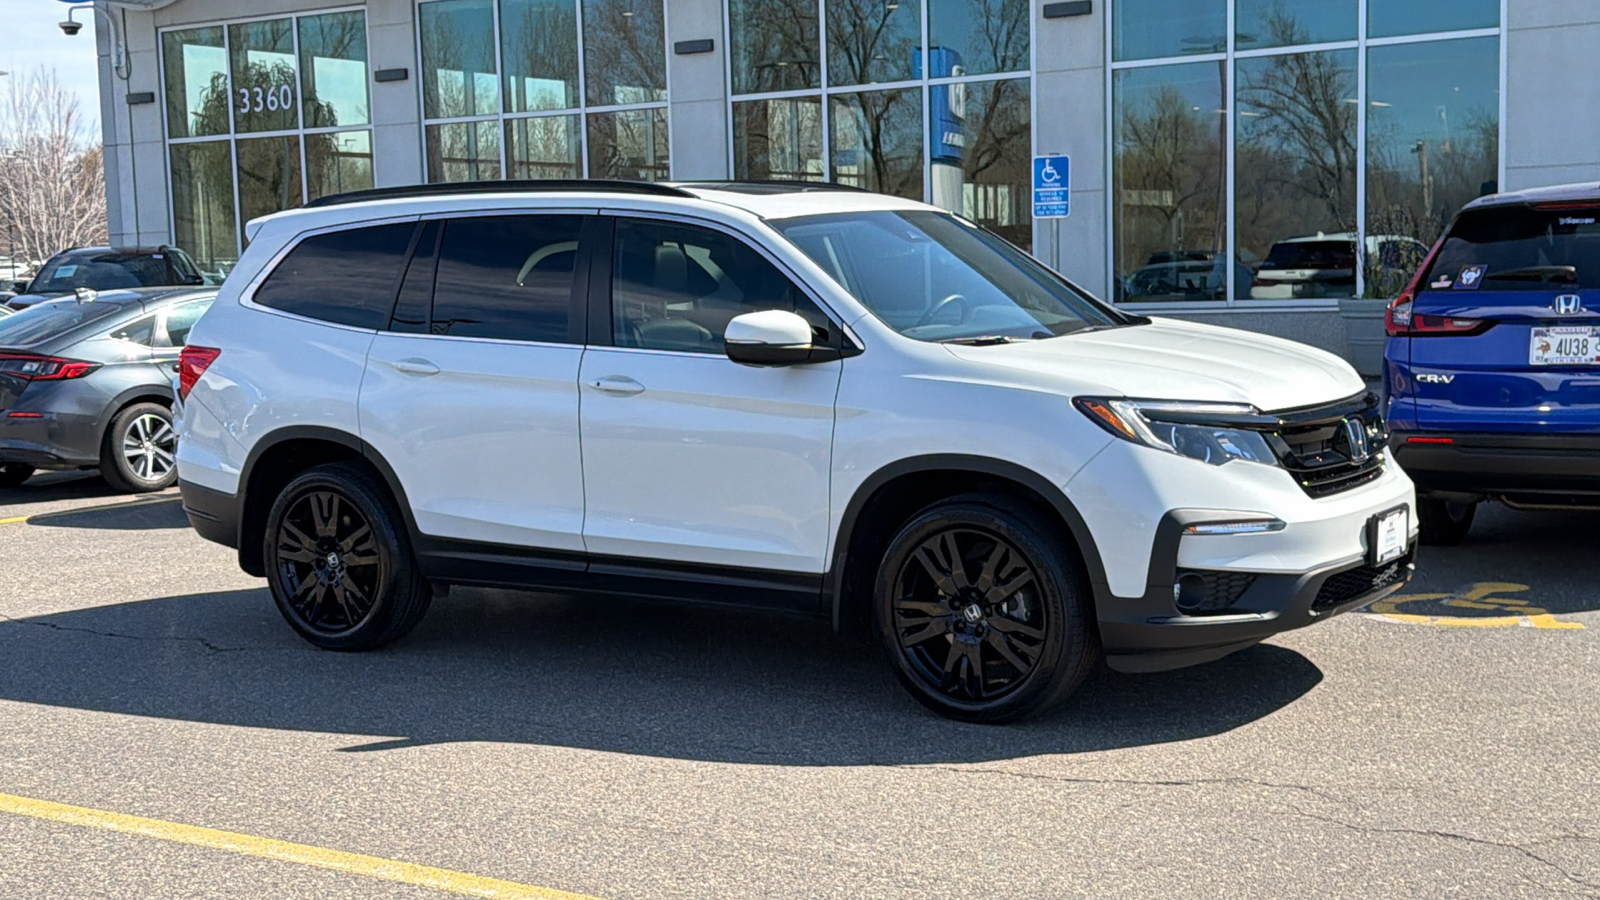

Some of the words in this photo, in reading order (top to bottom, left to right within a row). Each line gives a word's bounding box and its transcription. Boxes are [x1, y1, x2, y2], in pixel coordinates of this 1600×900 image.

[239, 84, 292, 113] 3360
[1555, 337, 1589, 357] 4U38
[1416, 374, 1455, 384] CR-V
